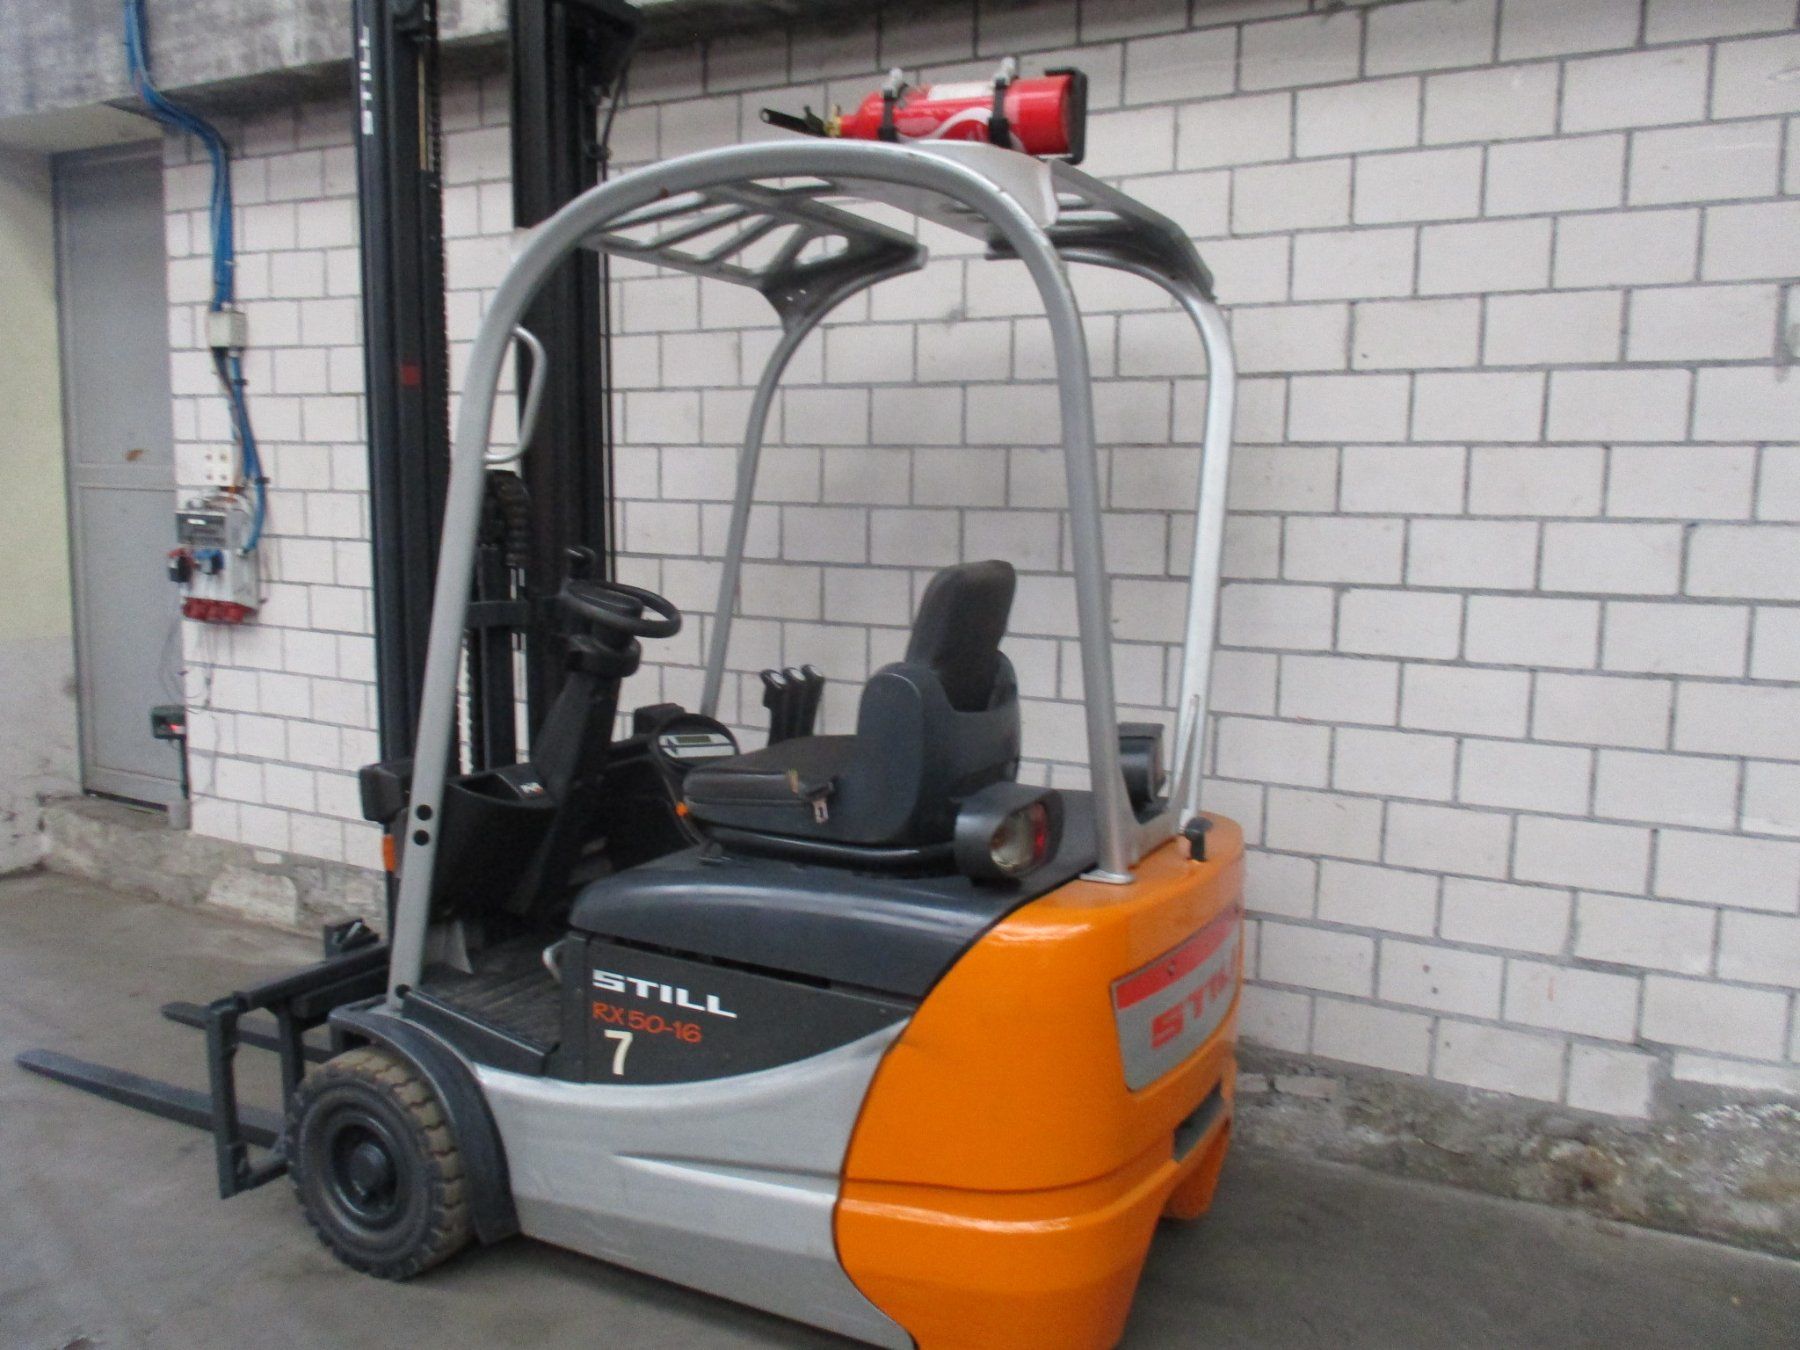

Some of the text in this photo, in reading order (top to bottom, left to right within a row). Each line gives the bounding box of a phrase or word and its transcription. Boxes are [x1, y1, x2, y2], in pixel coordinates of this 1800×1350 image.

[360, 26, 374, 135] STILL
[593, 969, 737, 1018] STILL
[604, 1030, 633, 1076] 7
